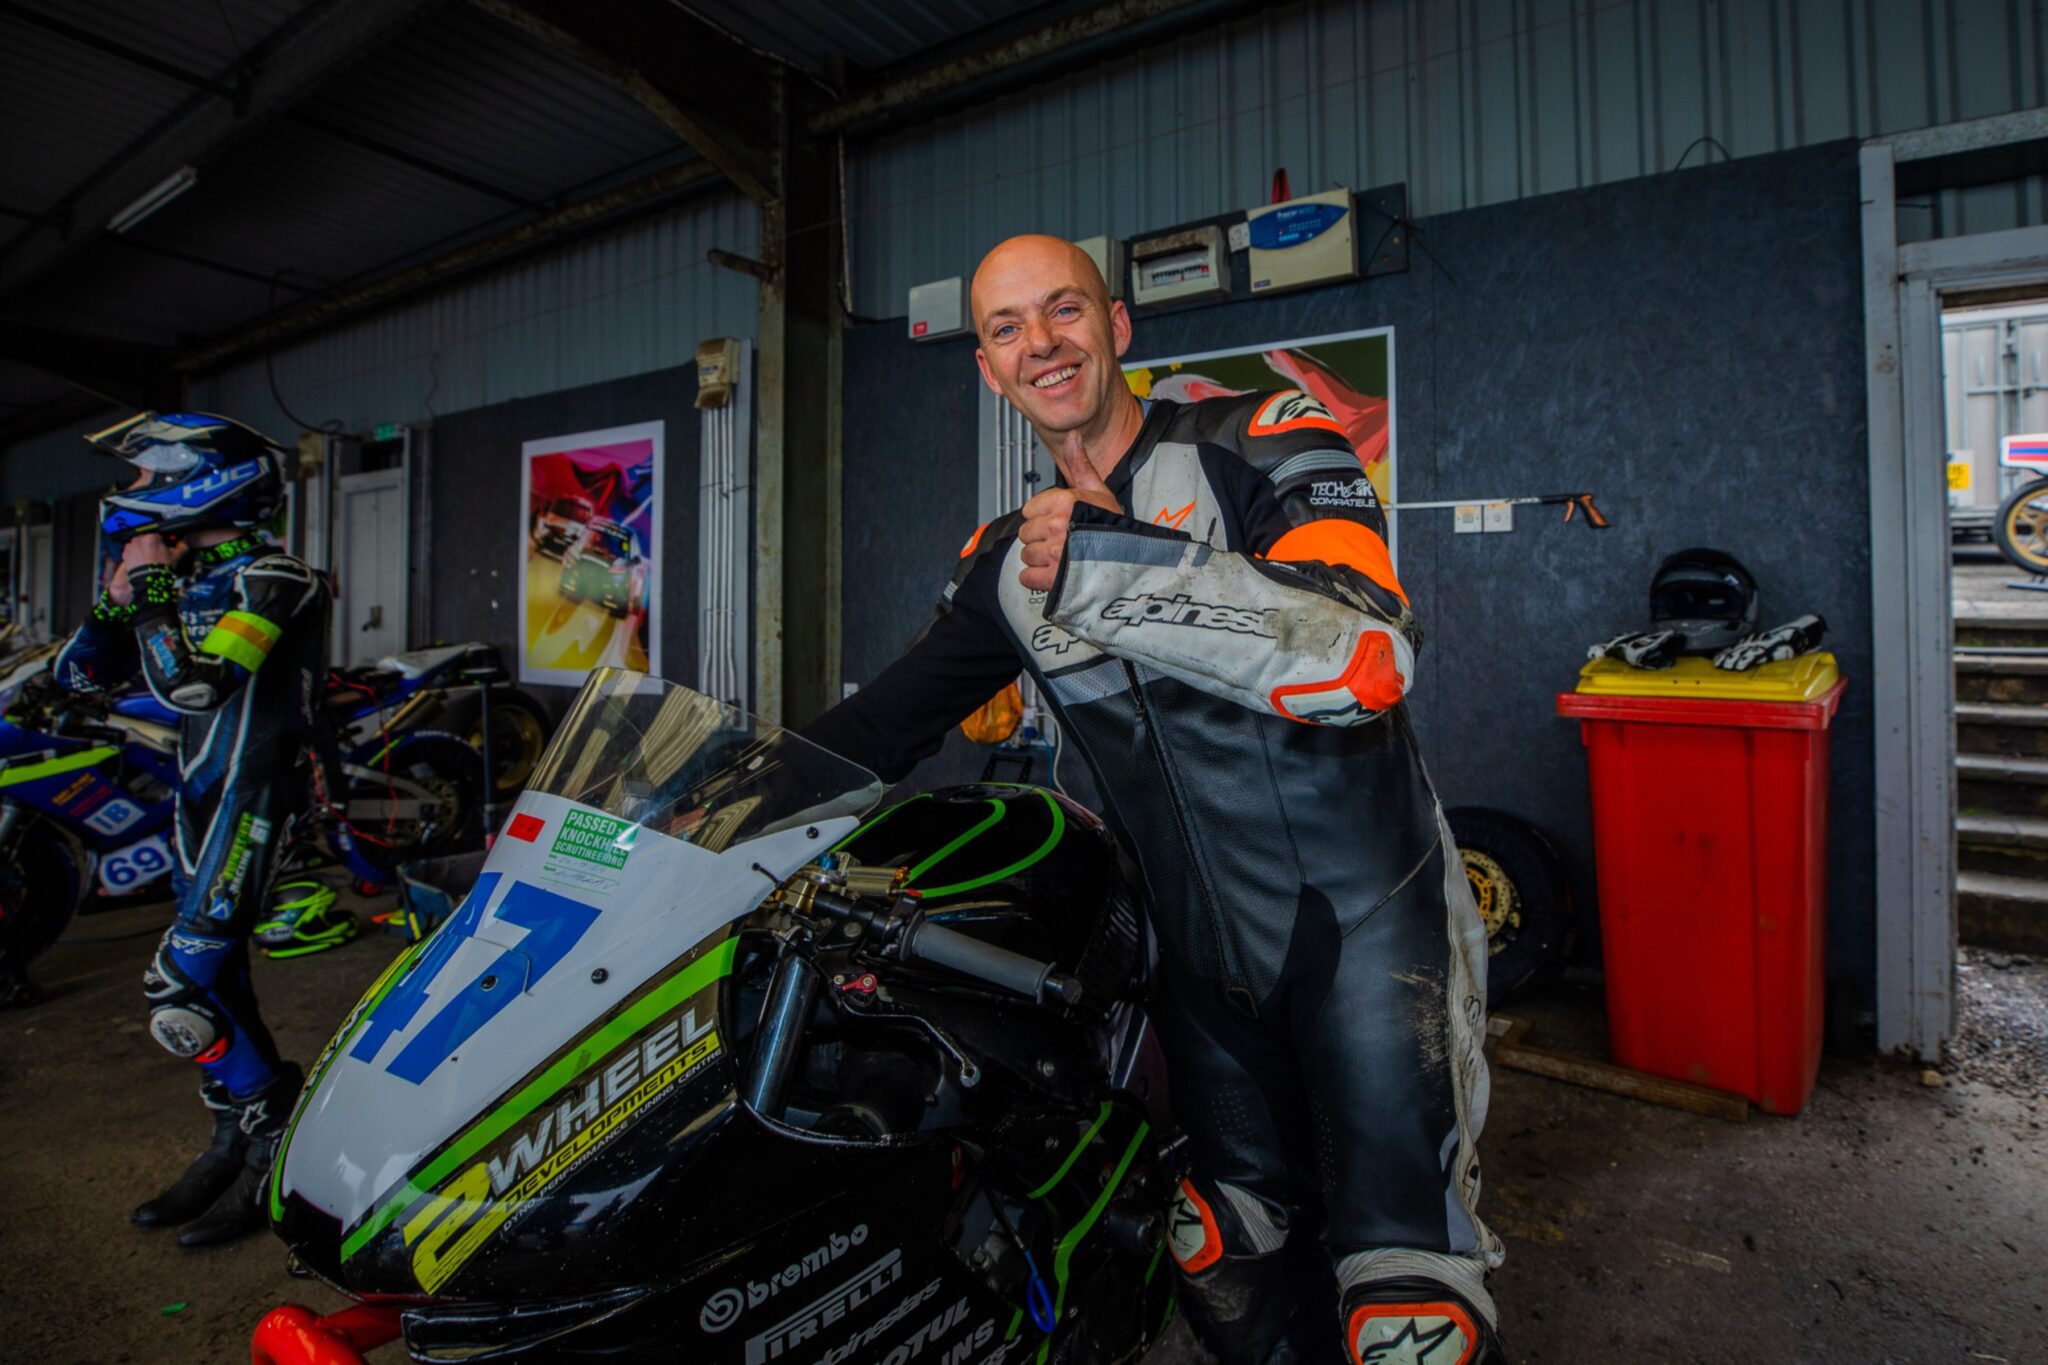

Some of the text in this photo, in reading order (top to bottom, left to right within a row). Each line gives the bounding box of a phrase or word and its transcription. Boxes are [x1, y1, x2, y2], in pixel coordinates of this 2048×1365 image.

[182, 462, 256, 500] HJC
[1309, 497, 1377, 508] COMPATIBLE
[566, 811, 617, 836] PASSED
[106, 847, 166, 885] 69
[554, 840, 625, 867] SCRUTINEERING
[504, 1040, 708, 1212] DEVELOPMENTS
[502, 1200, 536, 1232] DYNO
[540, 1120, 629, 1197] PERFORMANCE
[632, 1085, 675, 1119] TUNING
[748, 1224, 868, 1310] brembo
[745, 1248, 902, 1365] PIRELLI
[873, 1296, 970, 1365] OTUL
